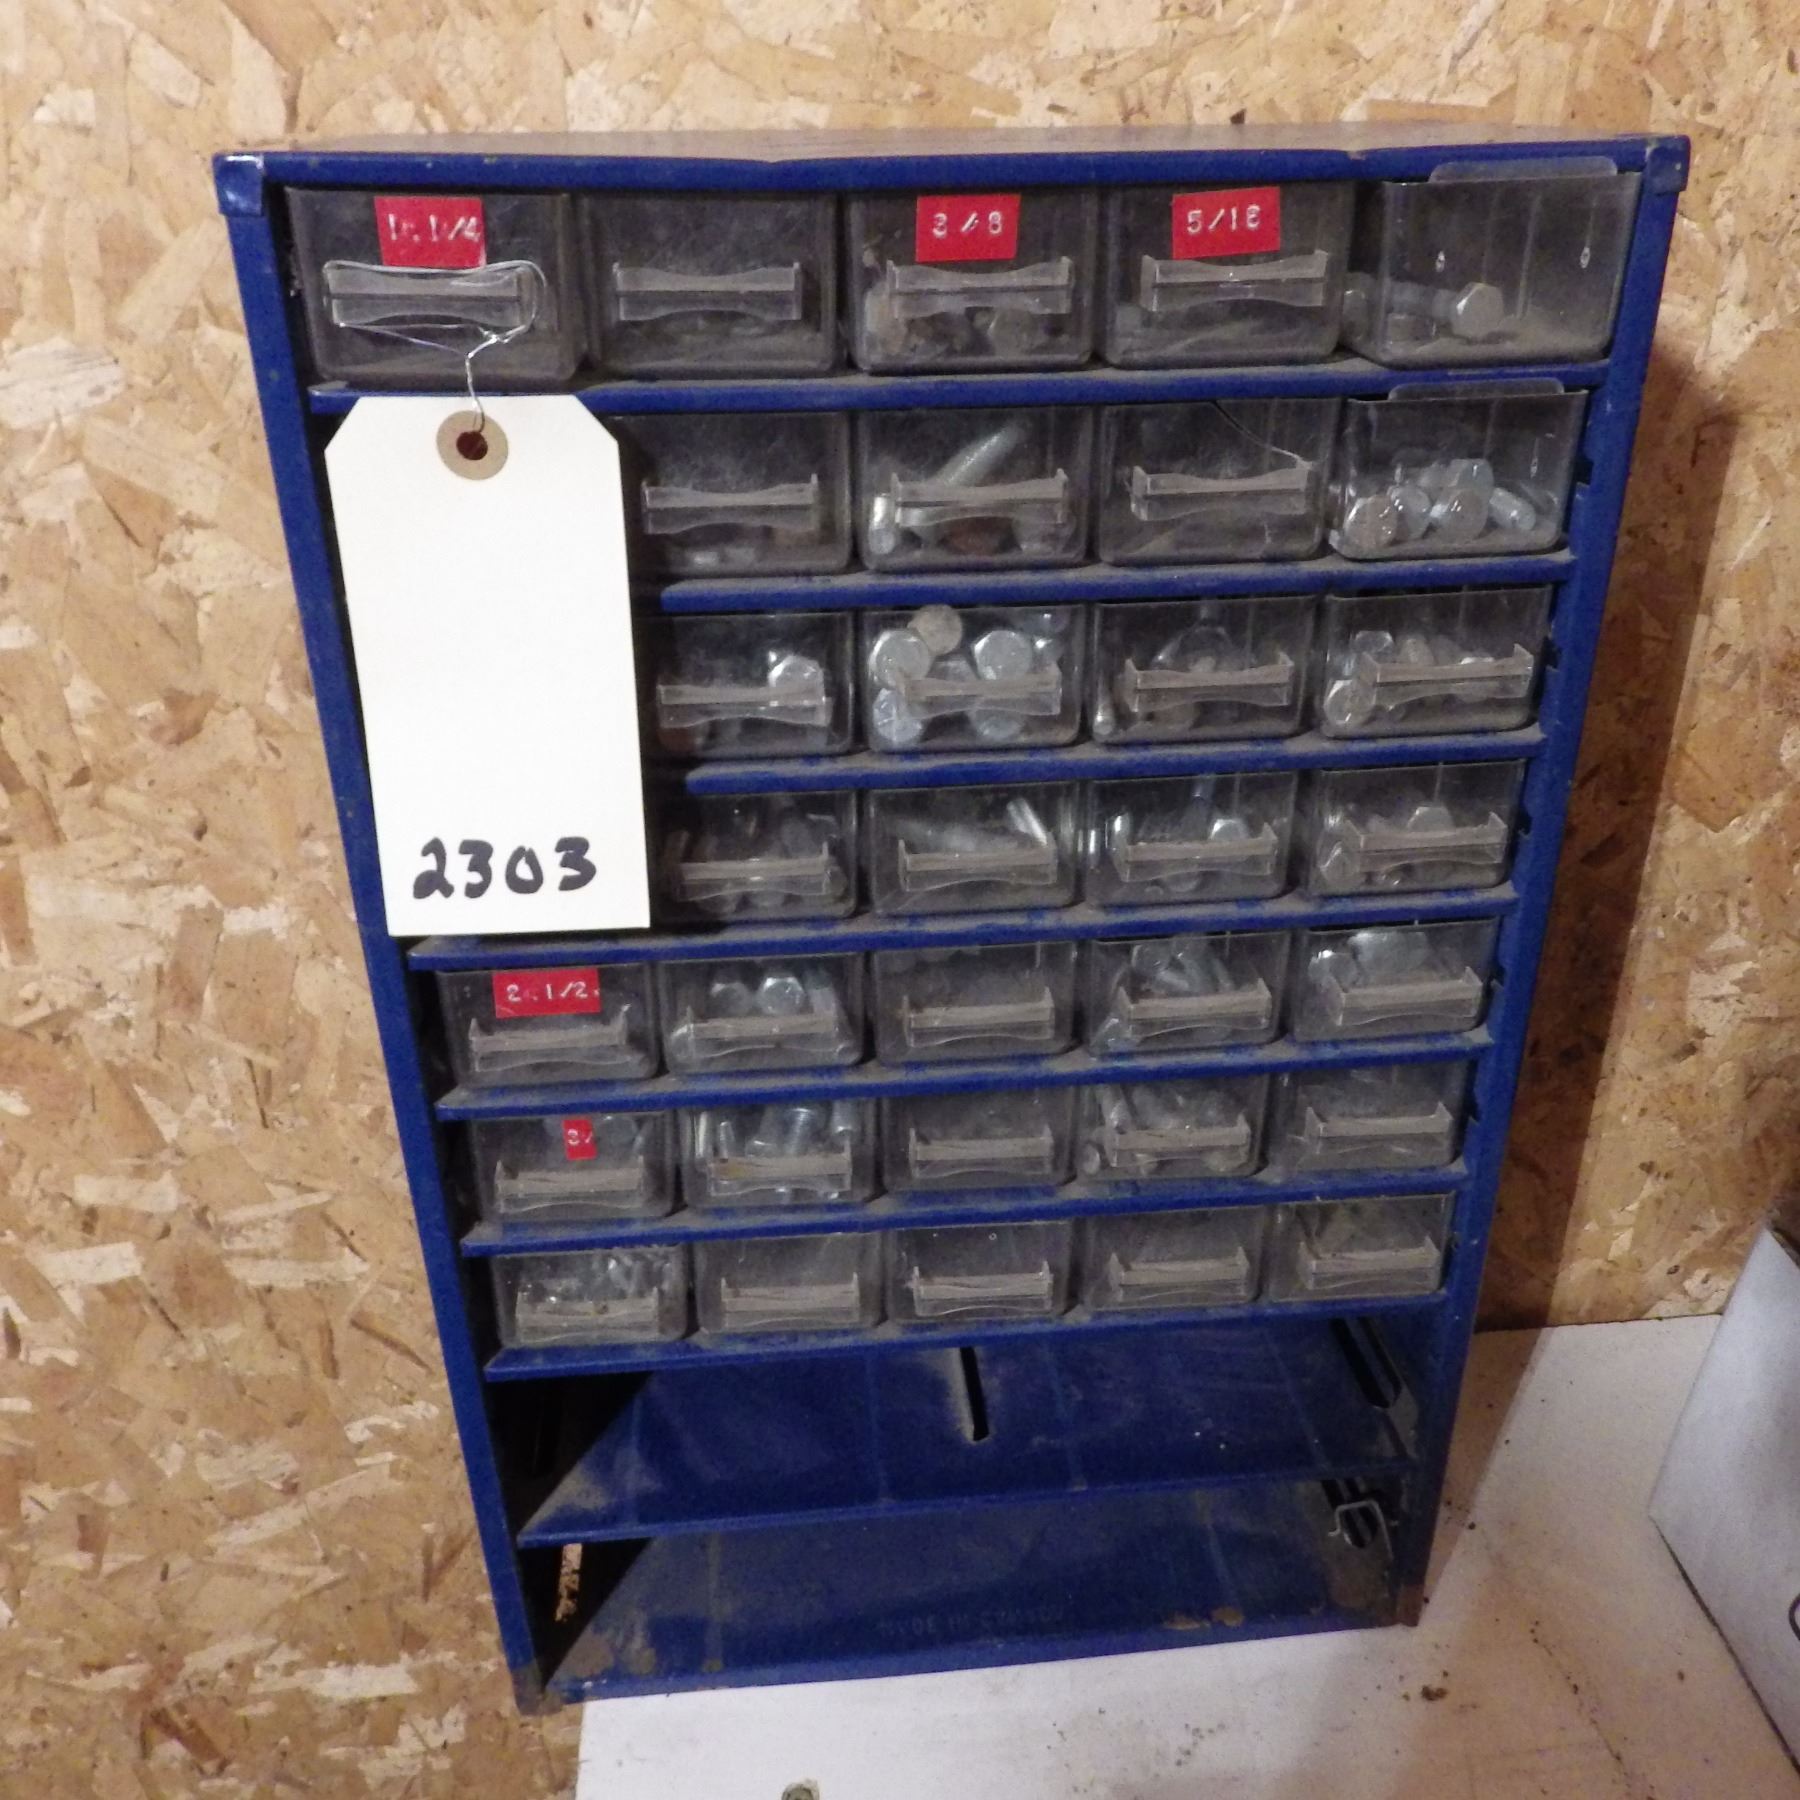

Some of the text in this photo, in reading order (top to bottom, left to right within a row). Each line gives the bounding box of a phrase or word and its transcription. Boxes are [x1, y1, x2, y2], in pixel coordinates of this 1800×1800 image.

[932, 210, 1003, 238] 3/8
[1186, 203, 1261, 234] 5/16
[413, 836, 597, 900] 2303
